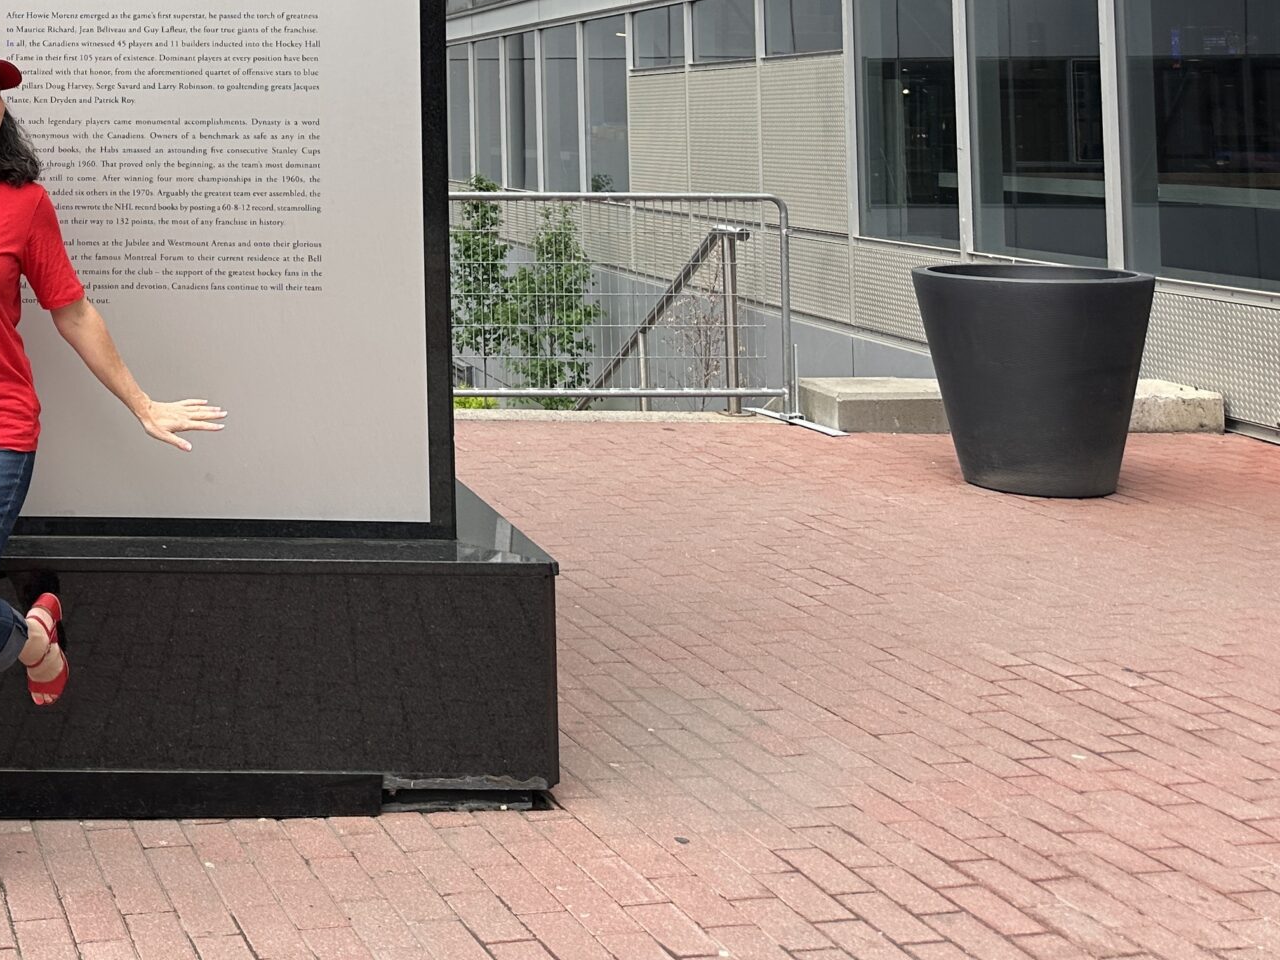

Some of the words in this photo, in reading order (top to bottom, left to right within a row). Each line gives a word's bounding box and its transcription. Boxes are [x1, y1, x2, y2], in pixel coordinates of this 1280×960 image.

[50, 96, 77, 105] Dryden
[46, 160, 75, 170] through
[119, 160, 143, 170] proved
[145, 160, 161, 170] only
[163, 160, 175, 168] the
[227, 160, 239, 168] the
[265, 160, 284, 168] most
[171, 282, 209, 290] Canadiens
[211, 282, 226, 290] fans
[270, 283, 284, 291] will
[285, 283, 303, 291] their
[304, 283, 322, 291] team
